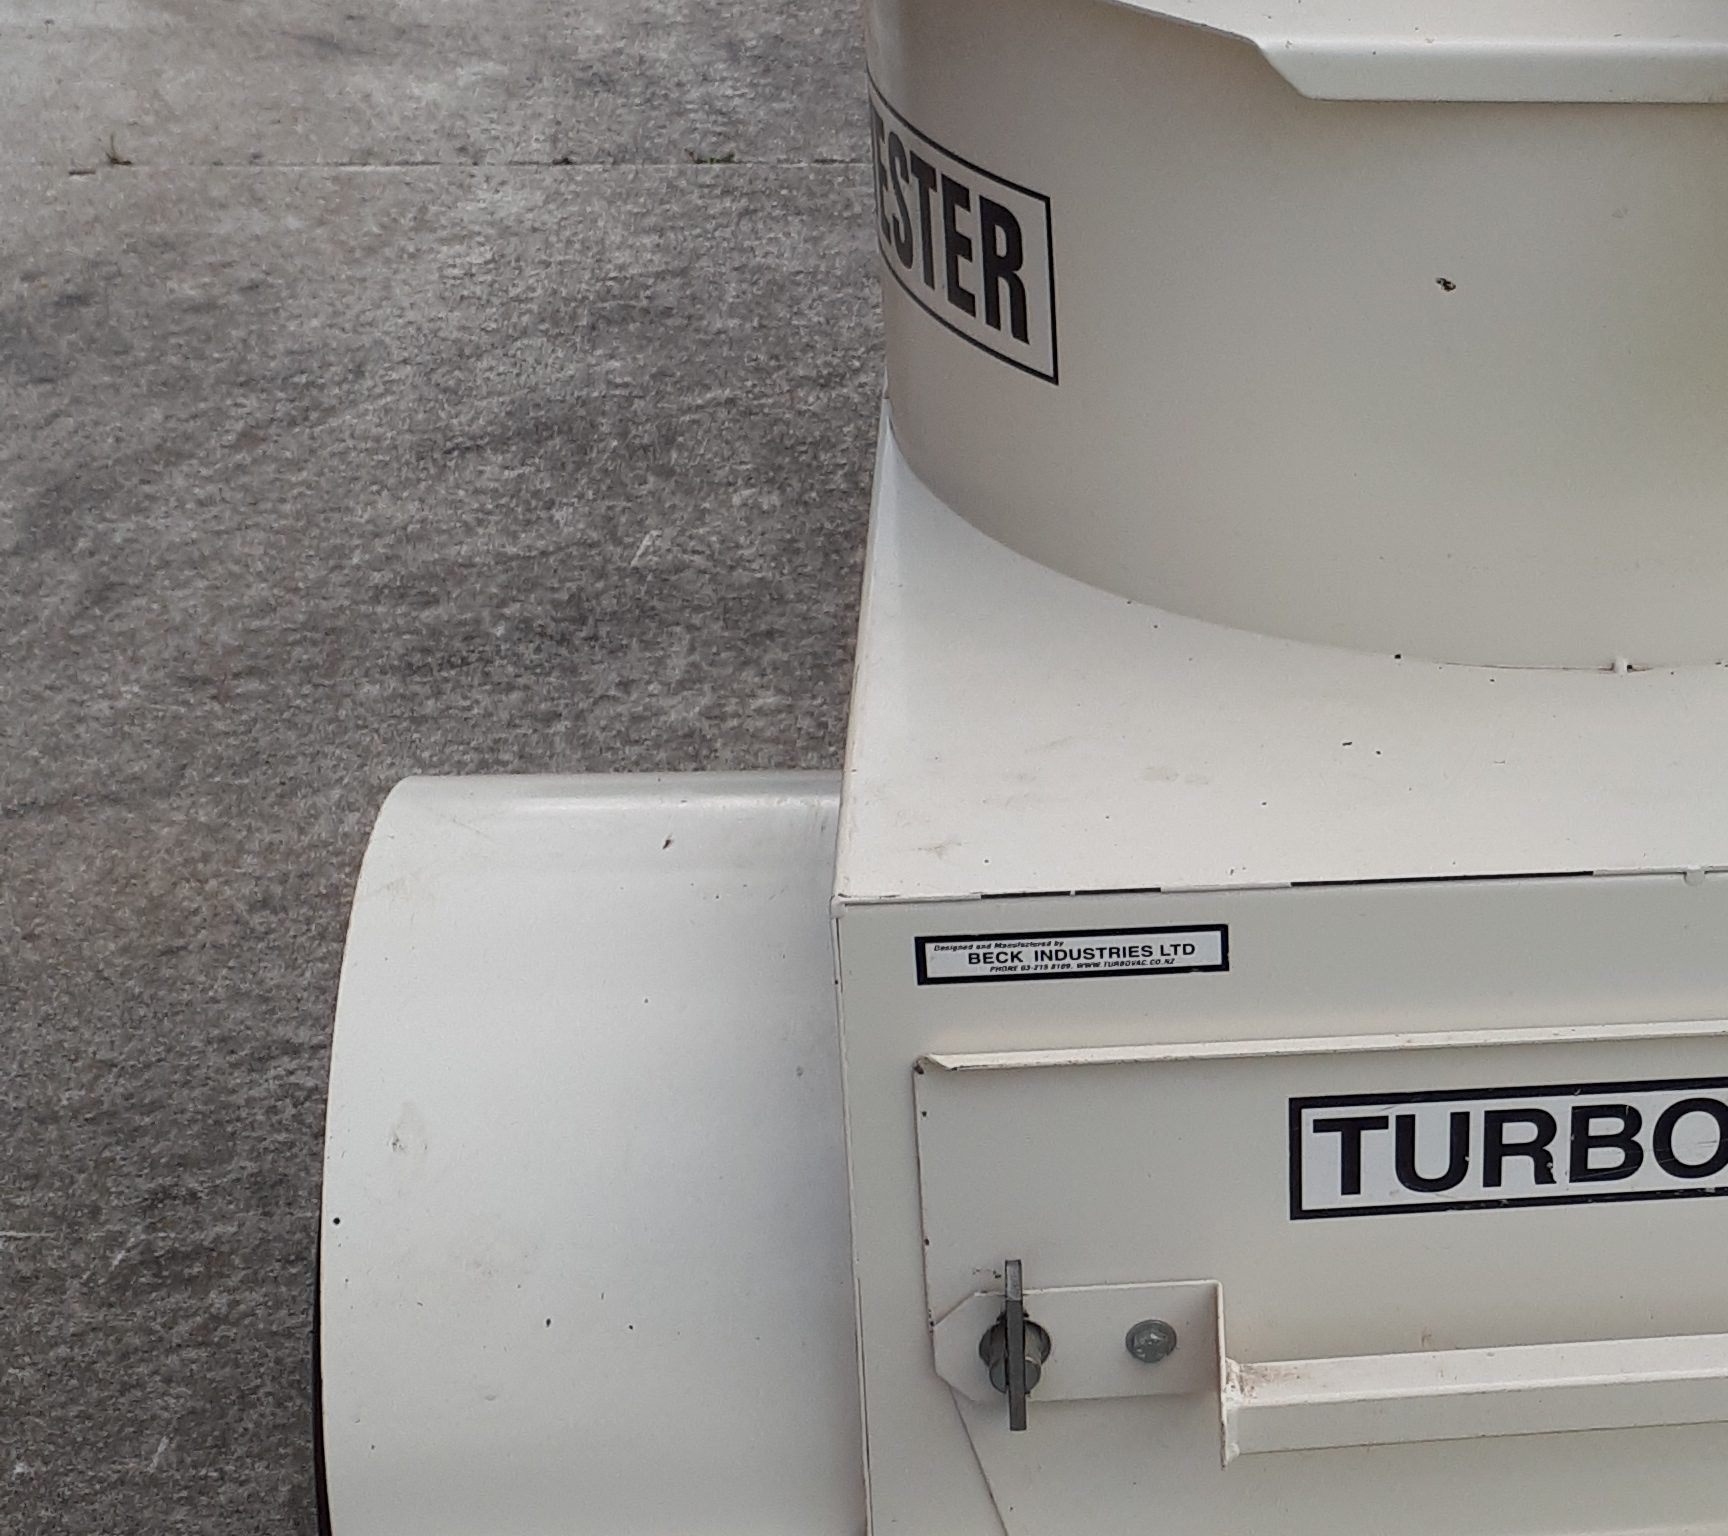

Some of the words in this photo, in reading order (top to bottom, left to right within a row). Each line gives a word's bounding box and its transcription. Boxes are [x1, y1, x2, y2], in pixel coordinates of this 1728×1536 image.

[1054, 940, 1064, 948] by
[968, 949, 1023, 965] BECK
[1034, 944, 1153, 962] INDUSTRIES
[1160, 943, 1195, 957] LTD
